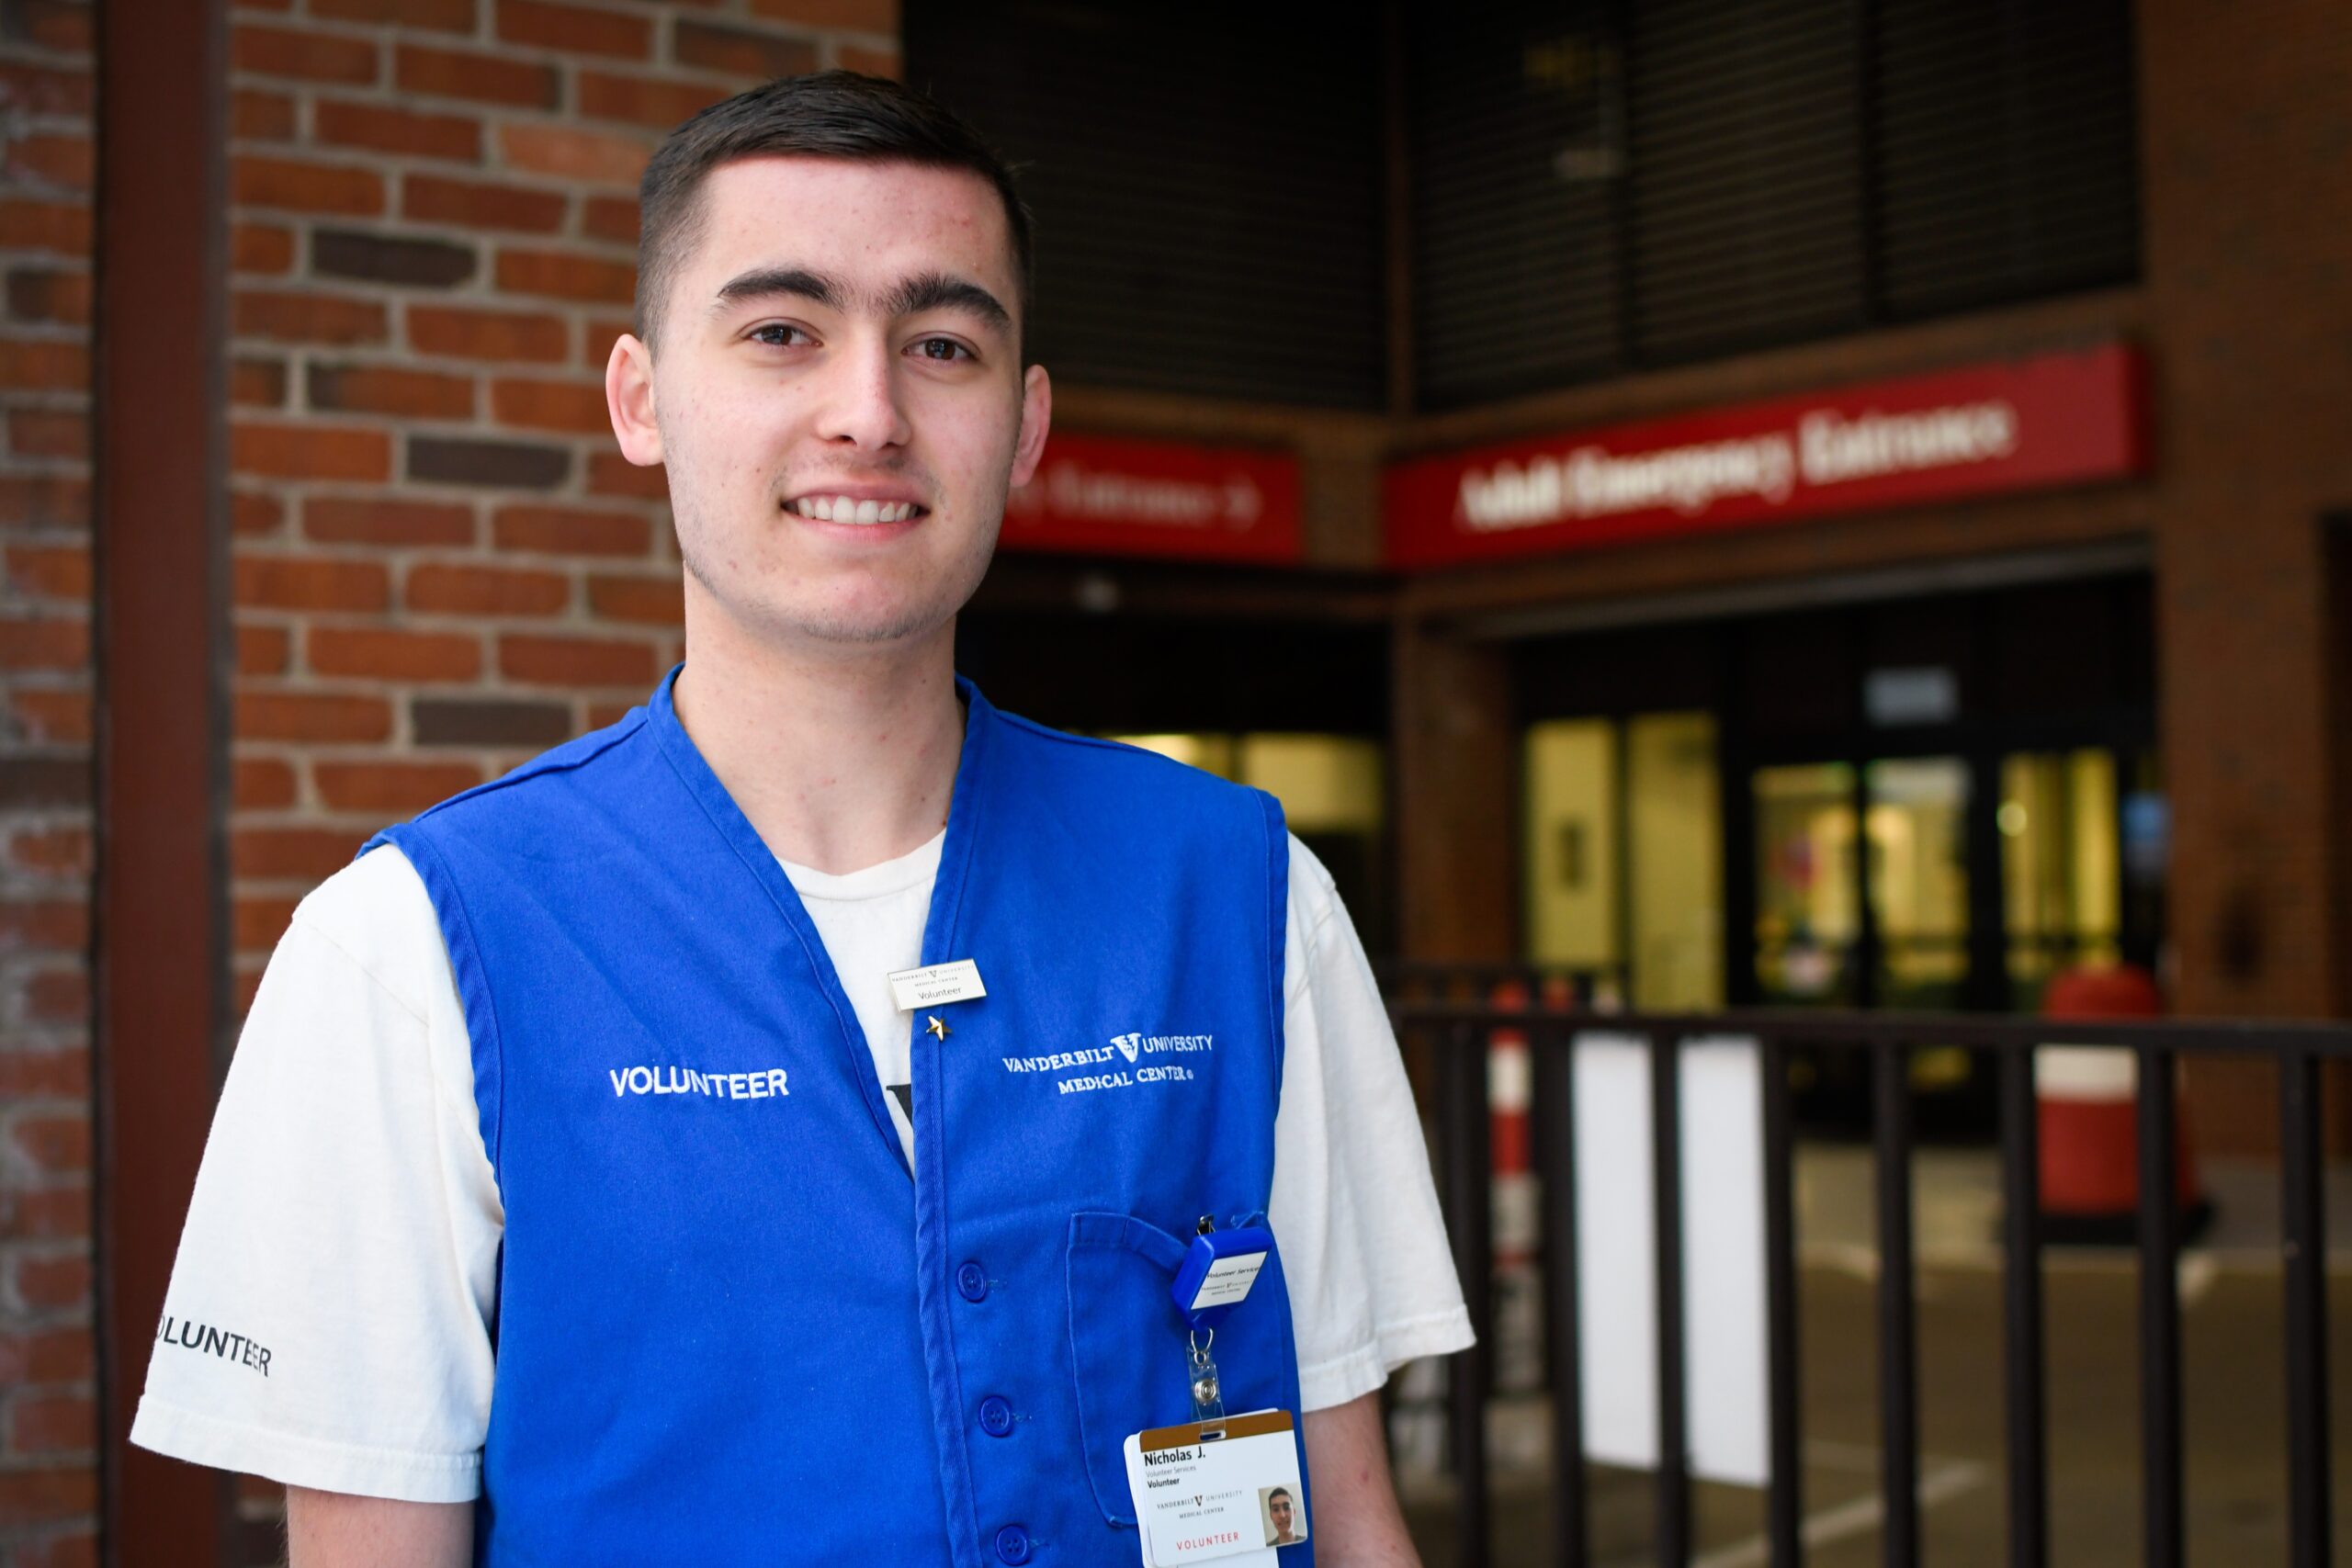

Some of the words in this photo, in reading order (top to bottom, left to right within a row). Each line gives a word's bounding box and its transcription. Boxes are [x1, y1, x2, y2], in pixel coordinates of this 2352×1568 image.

[918, 987, 962, 1000] Volunteer
[1002, 1045, 1114, 1073] VANDERBILT
[1142, 1034, 1214, 1054] UNIVERSITY
[609, 1066, 790, 1100] VOLUNTEER
[1057, 1071, 1133, 1094] MEDICAL
[157, 1314, 272, 1378] LUNTEER
[1144, 1448, 1193, 1467] Nicholas
[1197, 1445, 1206, 1459] J.
[1146, 1468, 1172, 1478] Volunteer
[1173, 1465, 1196, 1474] Services
[1147, 1477, 1180, 1489] Volunteer
[1157, 1498, 1193, 1510] VANDERBILT
[1205, 1490, 1242, 1502] UNIVERSITY
[1179, 1510, 1202, 1519] MEDICAL
[1204, 1506, 1224, 1516] CENTER
[1176, 1531, 1239, 1551] VOLUNTEER
